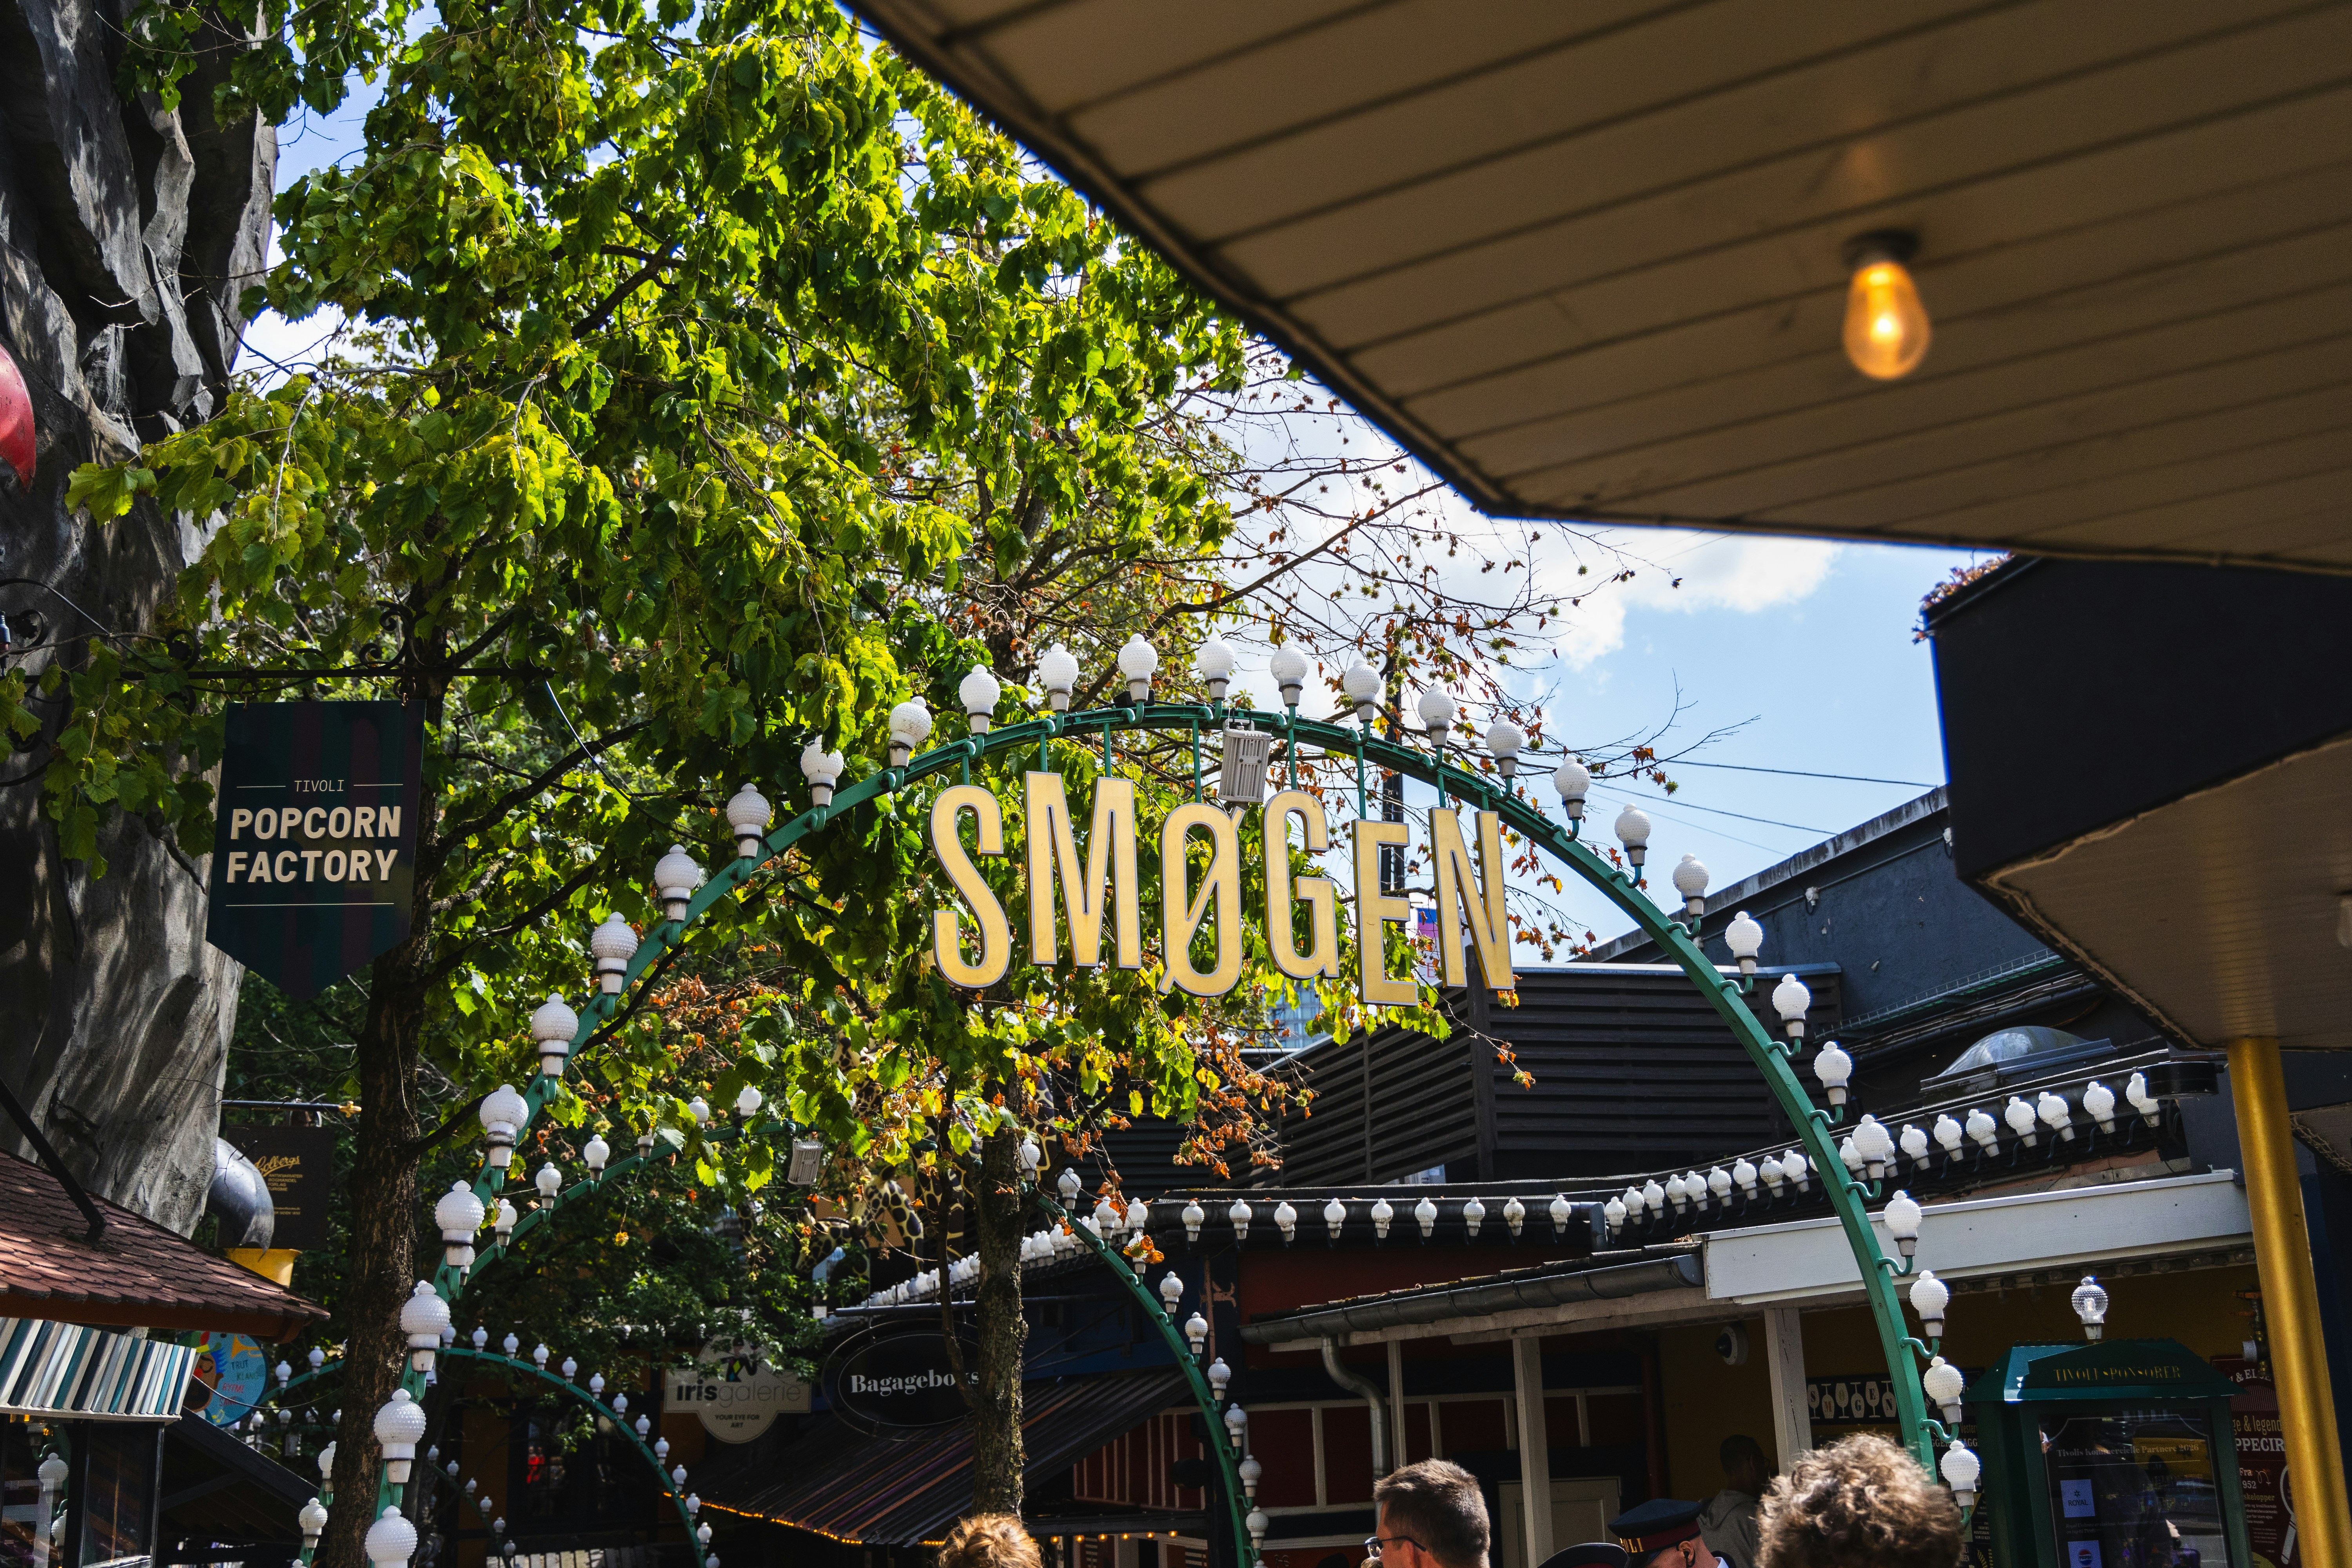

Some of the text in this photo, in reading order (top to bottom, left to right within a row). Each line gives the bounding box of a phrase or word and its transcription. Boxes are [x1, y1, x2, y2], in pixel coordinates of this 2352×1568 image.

[294, 779, 344, 793] TIVOLI
[230, 806, 402, 840] POPCORN
[227, 849, 398, 883] FACTORY
[929, 770, 1515, 1007] SMØGEN
[231, 1359, 248, 1370] TRUT
[850, 1369, 979, 1397] Bagagebos
[2253, 1415, 2282, 1436] legend
[2235, 1437, 2285, 1452] PPECIR
[2056, 1448, 2083, 1457] Tivolis
[2242, 1480, 2257, 1489] 952
[2243, 1492, 2275, 1502] skelopper
